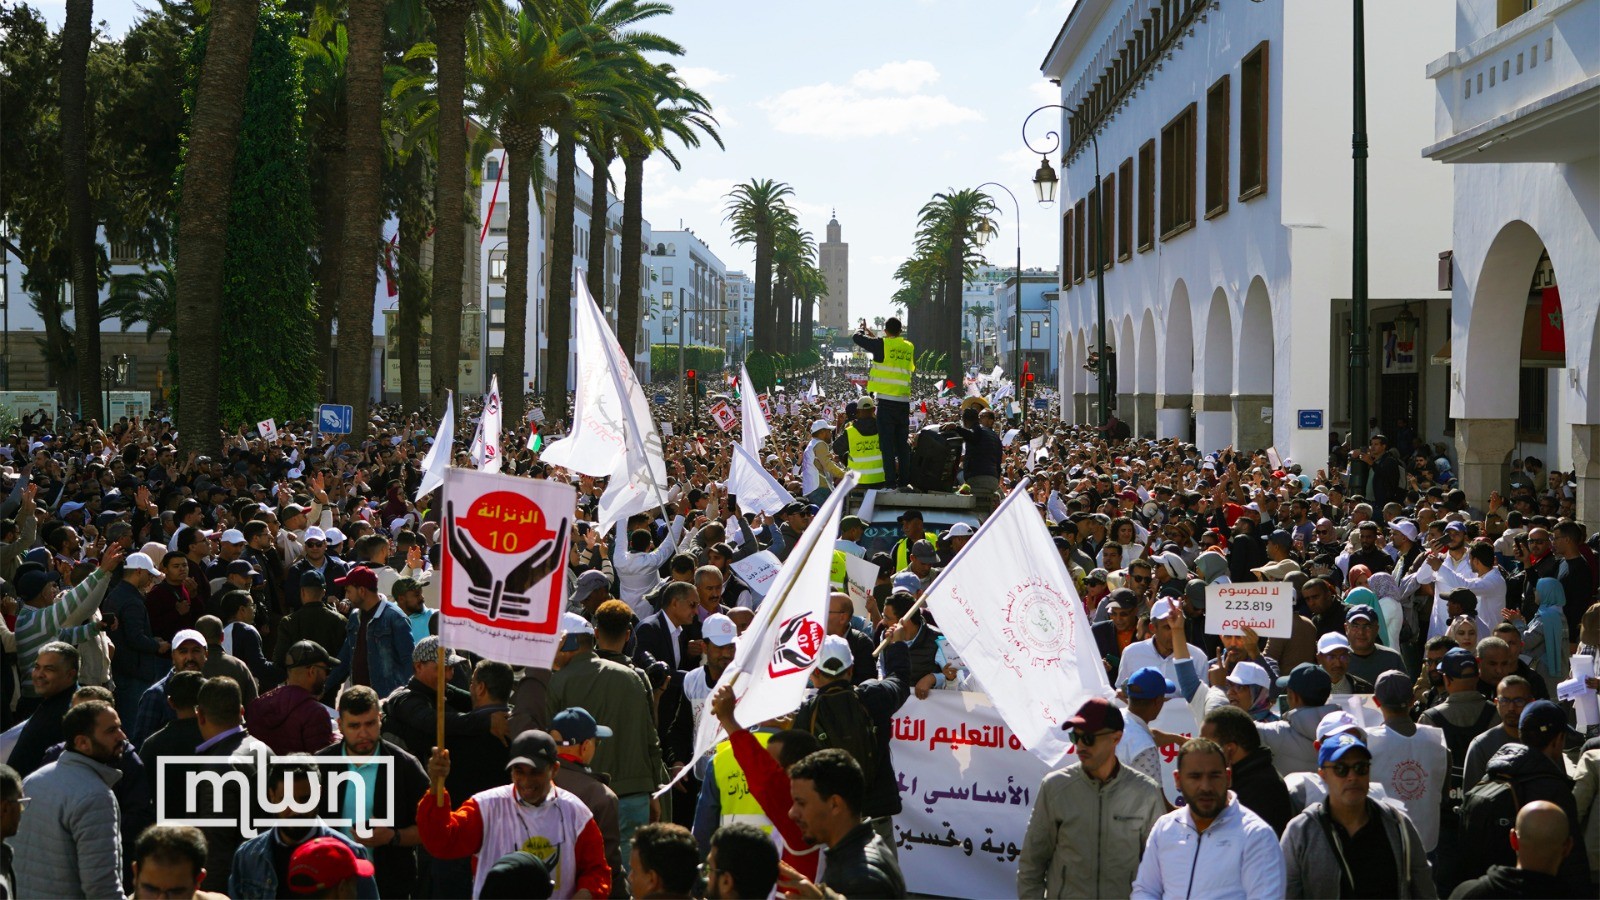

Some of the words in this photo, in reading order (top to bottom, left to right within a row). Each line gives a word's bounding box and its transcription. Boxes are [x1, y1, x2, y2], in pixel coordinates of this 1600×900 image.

[477, 501, 539, 524] الزنزانة
[489, 530, 518, 552] 10
[1219, 587, 1267, 597] للمرسوم
[1271, 587, 1279, 595] لا
[1225, 600, 1273, 611] 2.23.819
[929, 722, 1003, 751] التعليم
[923, 776, 1029, 813] الأساسي
